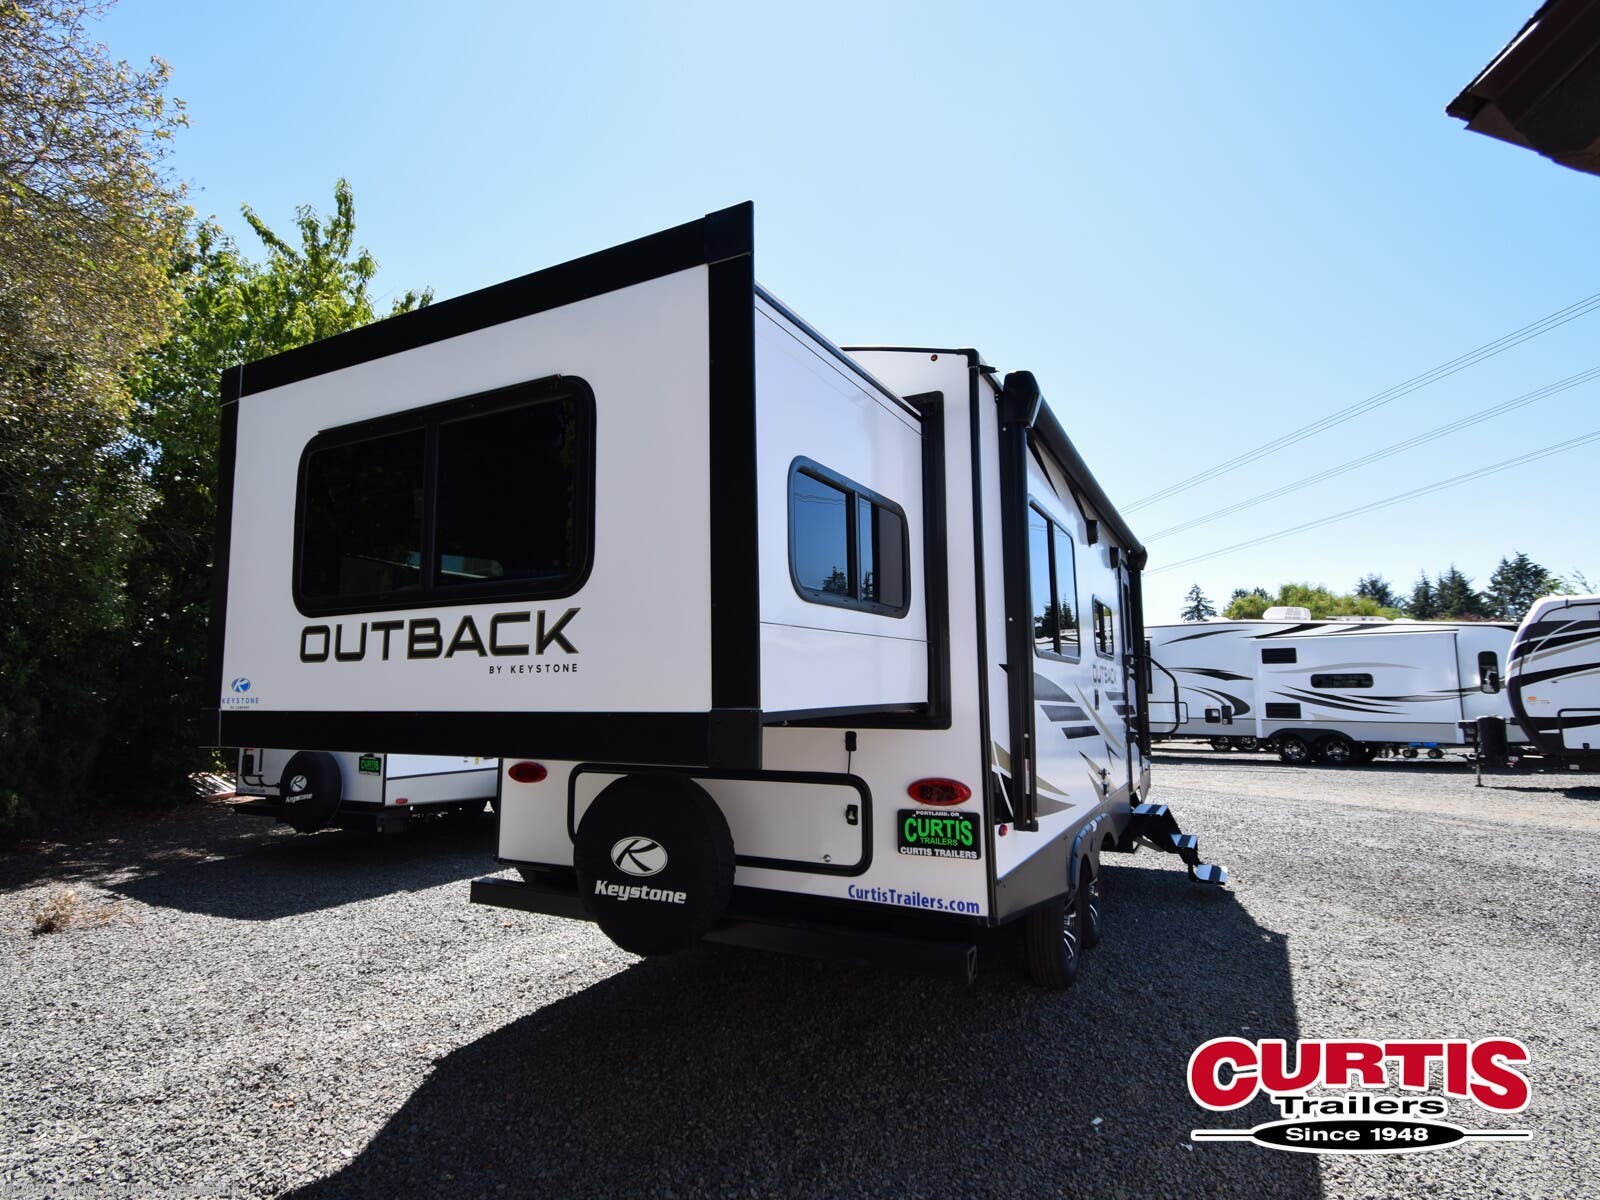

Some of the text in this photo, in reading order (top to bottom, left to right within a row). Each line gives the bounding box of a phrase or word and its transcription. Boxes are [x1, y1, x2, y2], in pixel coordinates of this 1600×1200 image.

[300, 608, 580, 662] OUTBACK
[488, 663, 578, 674] BY KEYSTONE
[904, 817, 973, 846] CURTIS
[920, 836, 958, 847] TRAILERS
[900, 846, 978, 859] CURTIS TRAILERS
[594, 879, 687, 905] Keystone
[848, 884, 980, 914] CurtisTrailers.com
